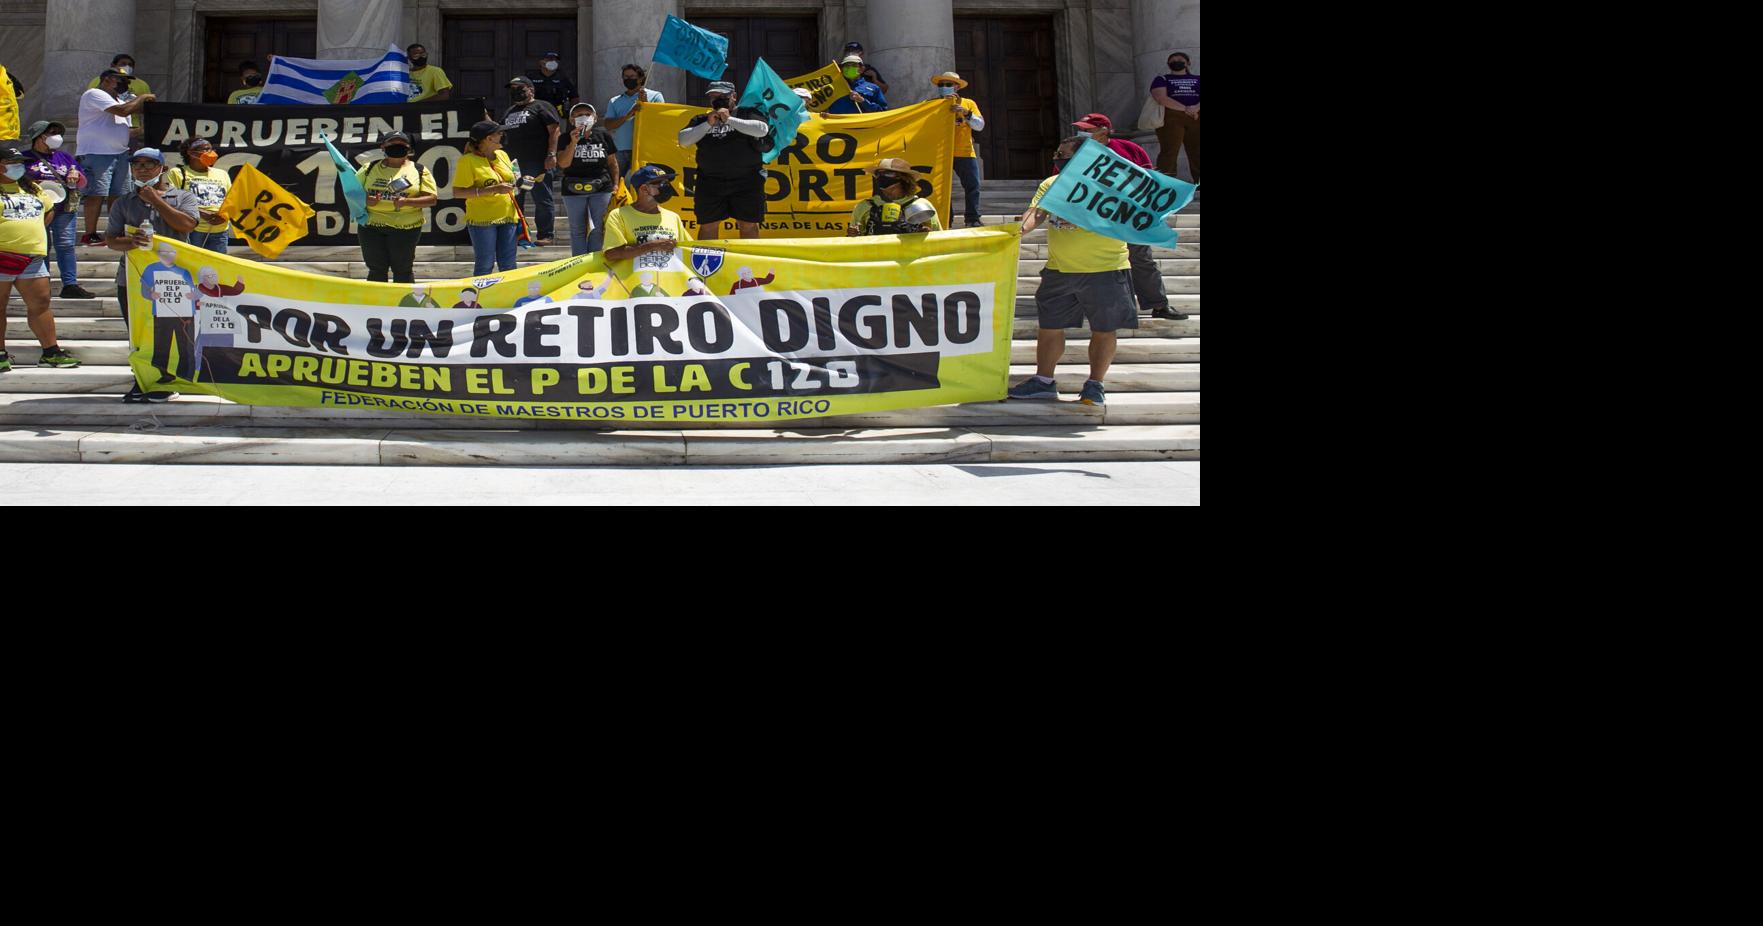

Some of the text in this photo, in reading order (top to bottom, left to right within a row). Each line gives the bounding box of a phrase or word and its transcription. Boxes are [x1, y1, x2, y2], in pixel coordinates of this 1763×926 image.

[161, 111, 470, 148] APRUEBEN EL
[574, 150, 606, 158] DEUDA
[1082, 153, 1177, 213] RETIRO
[254, 189, 295, 221] PC
[1066, 181, 1154, 231] DIGNO
[230, 208, 281, 243] 120
[792, 221, 811, 231] DE
[816, 222, 843, 231] LAS
[236, 291, 981, 359] POR UN RETIRO DIGNO
[239, 352, 860, 396] APRUEBEN EL P DE LA C 120
[321, 390, 831, 419] FEDERACIÓN DE MAESTROS DE PUERTO RICO
